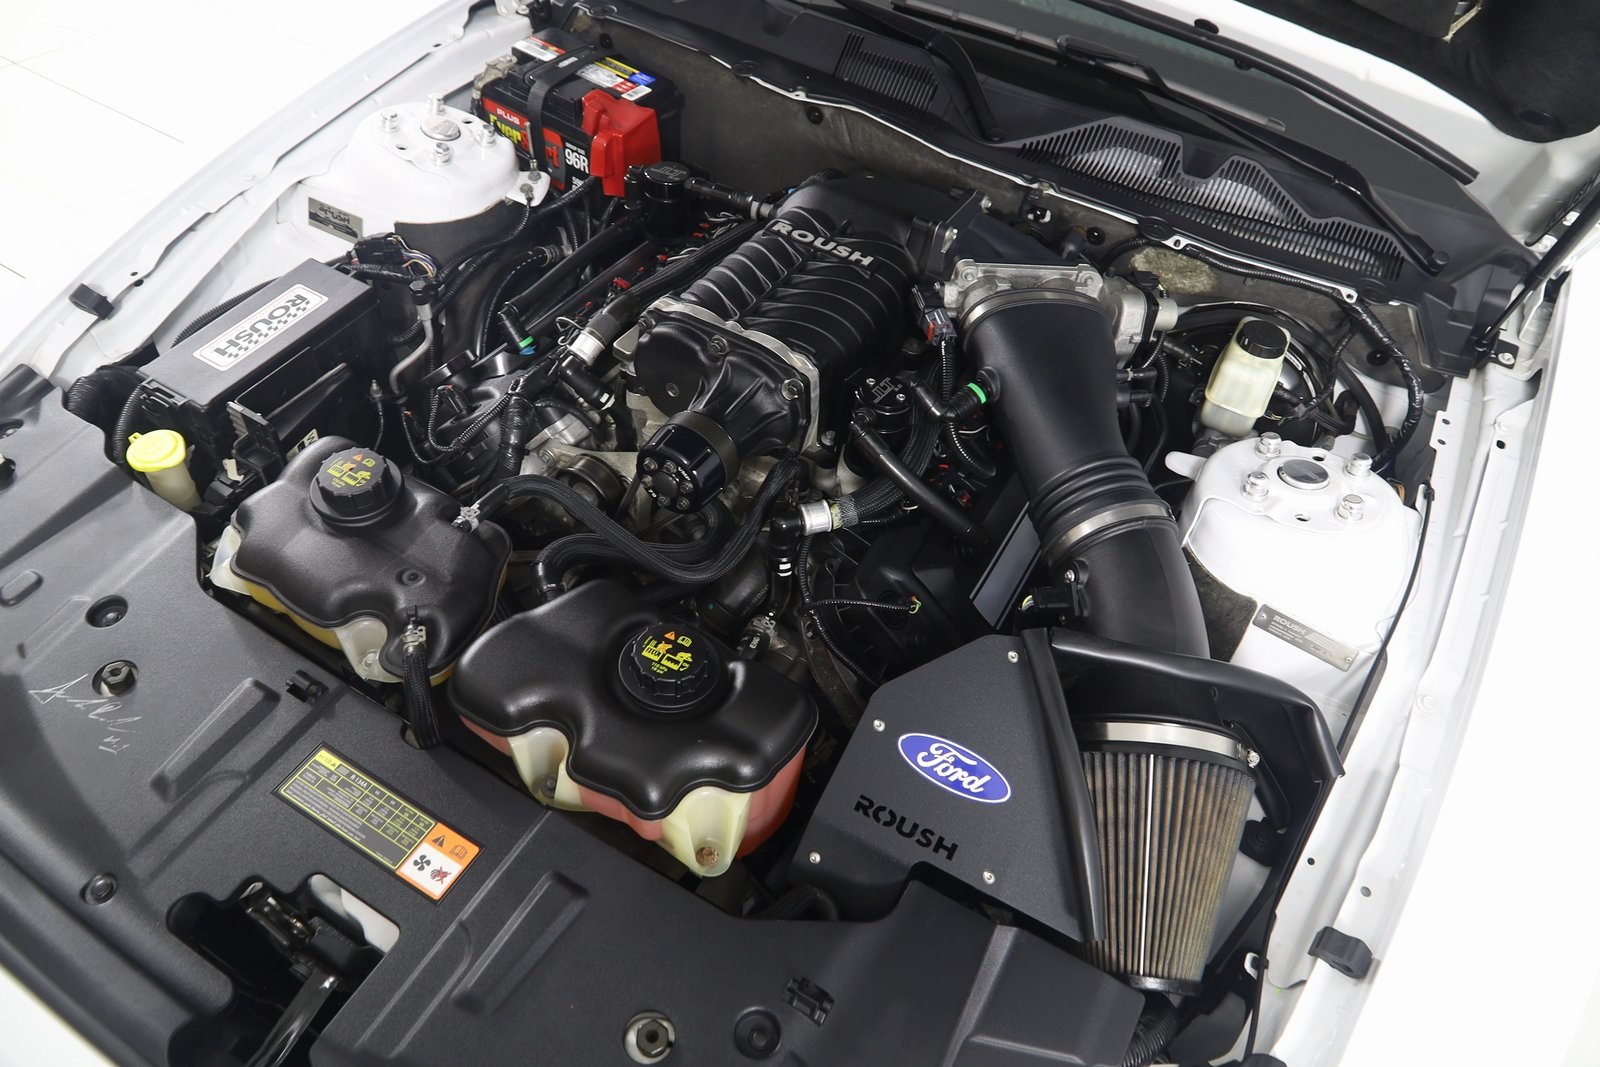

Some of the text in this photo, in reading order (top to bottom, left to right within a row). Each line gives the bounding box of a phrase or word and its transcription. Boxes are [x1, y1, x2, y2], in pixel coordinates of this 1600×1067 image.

[496, 108, 520, 125] PLUS
[564, 148, 590, 174] 96R
[771, 221, 875, 267] ROUSH
[213, 294, 309, 357] ROUSH
[1273, 615, 1306, 636] ROUSH
[916, 742, 992, 793] Ford
[853, 794, 959, 861] ROUSH
